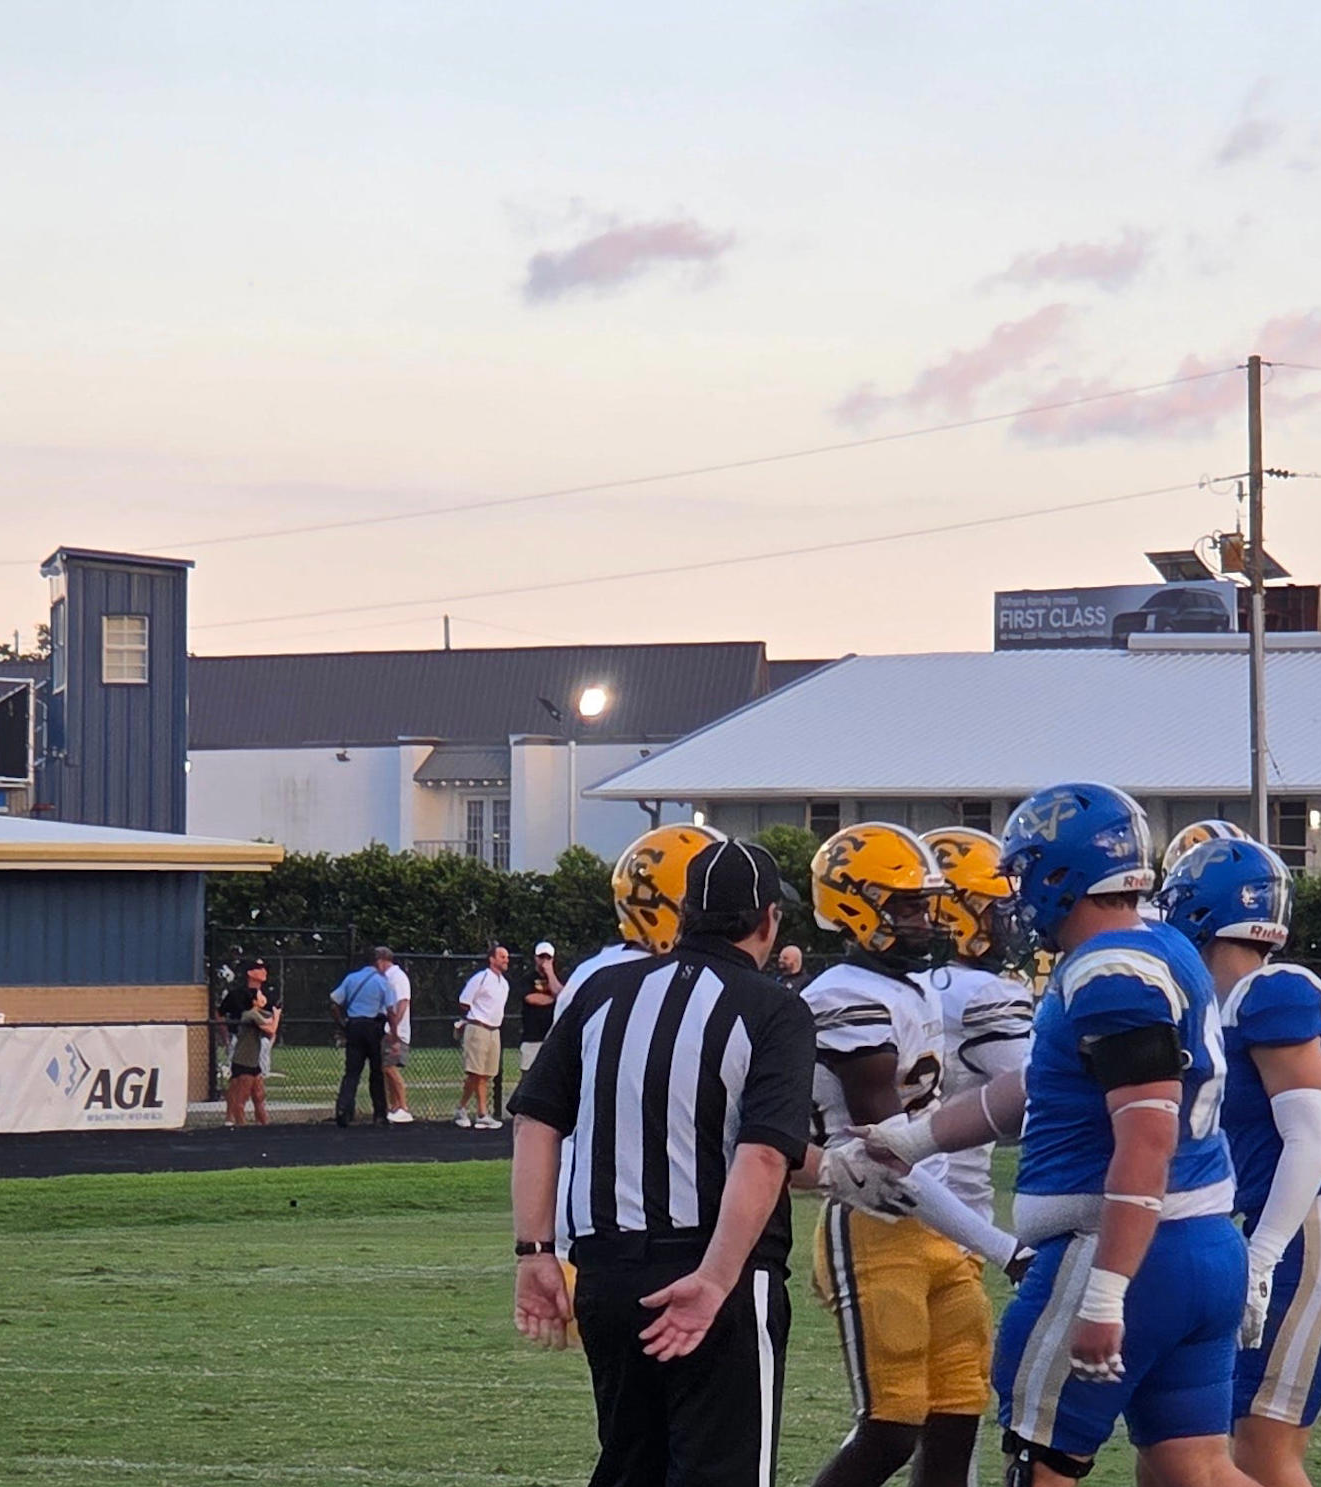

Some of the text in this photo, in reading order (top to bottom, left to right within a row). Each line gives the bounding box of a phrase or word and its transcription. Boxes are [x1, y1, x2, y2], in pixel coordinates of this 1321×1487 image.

[1000, 606, 1106, 629] FIRST CLASS
[84, 1067, 164, 1110] AGL
